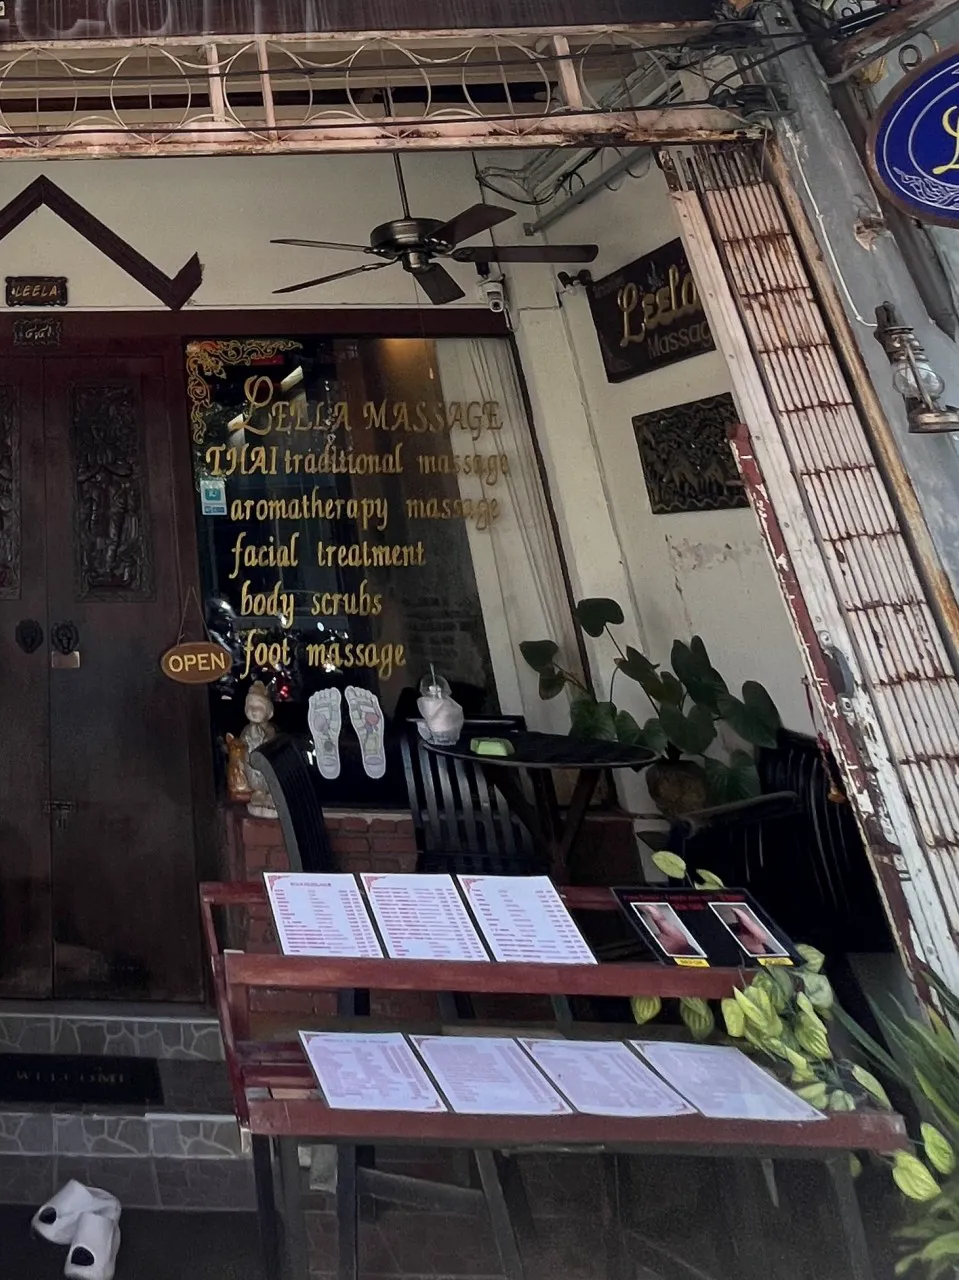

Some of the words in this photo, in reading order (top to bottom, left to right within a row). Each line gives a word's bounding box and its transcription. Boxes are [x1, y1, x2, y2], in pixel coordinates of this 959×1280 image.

[15, 284, 58, 297] LEELA
[647, 321, 712, 360] Massag
[362, 398, 504, 440] MASSAGE
[205, 444, 278, 477] THAI
[284, 442, 404, 475] traditional
[418, 452, 511, 485] massage
[230, 486, 389, 530] aromatherapy
[406, 496, 501, 530] massage
[229, 532, 300, 578] facial
[317, 540, 426, 568] treatment
[240, 580, 295, 627] body
[311, 580, 382, 617] scrubs
[169, 652, 226, 672] OPEN
[239, 632, 291, 681] foot
[307, 640, 407, 681] massage
